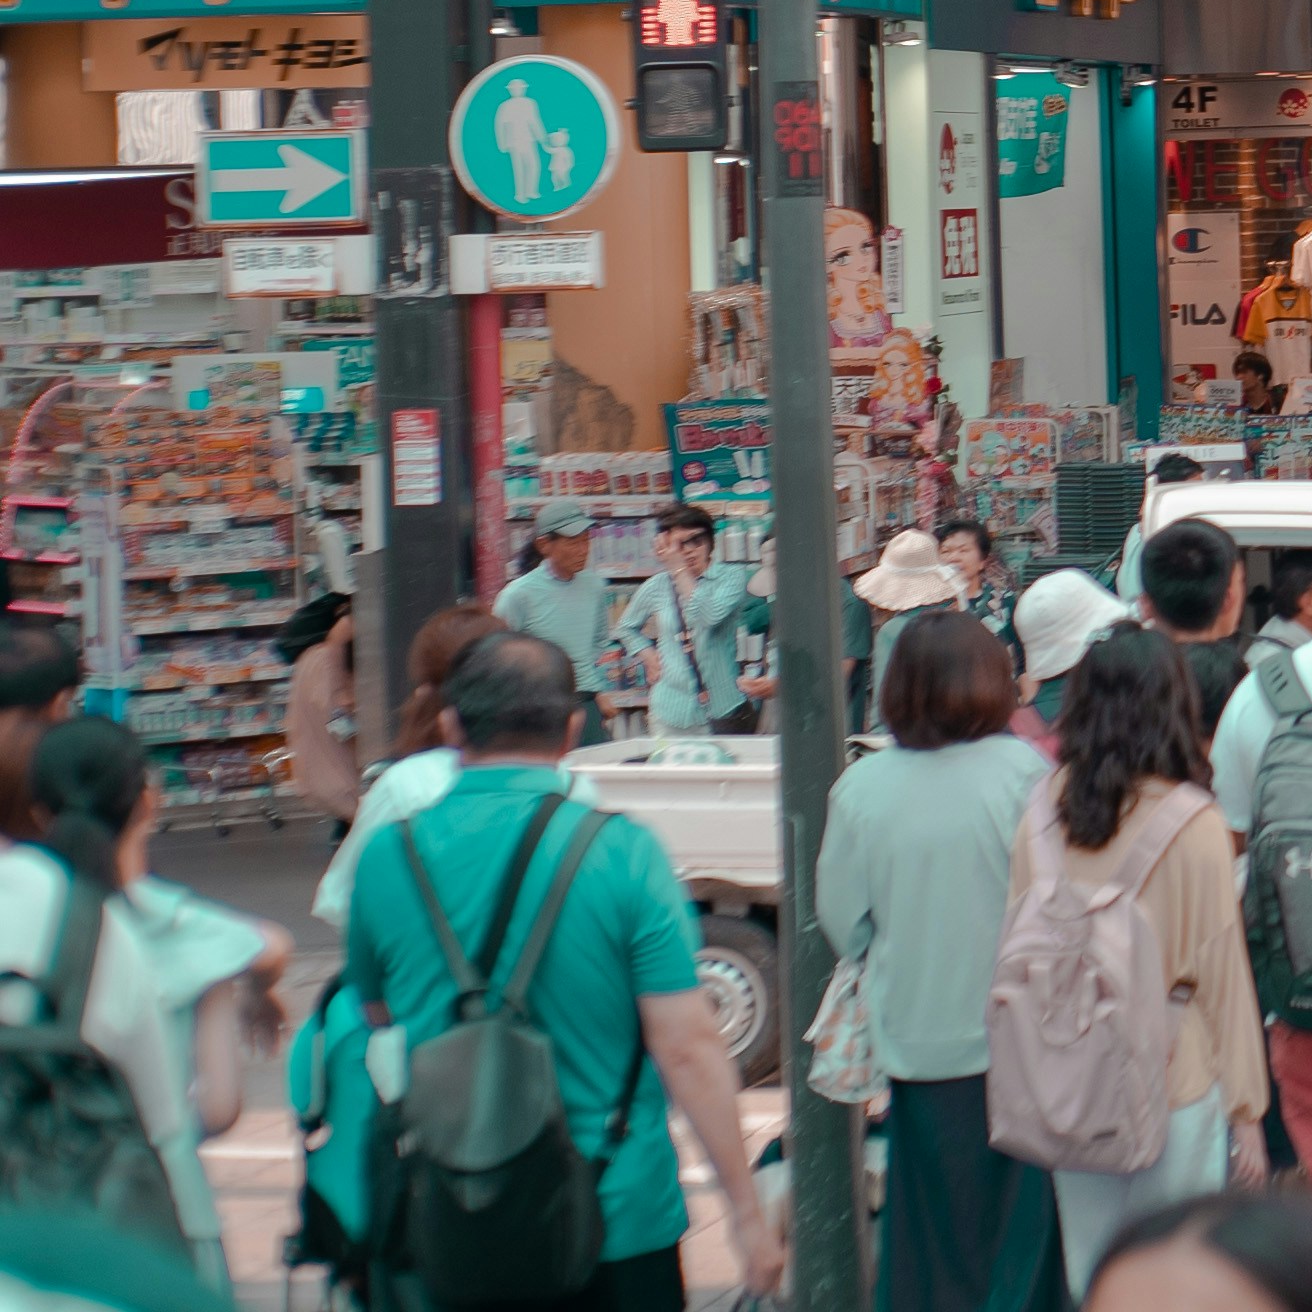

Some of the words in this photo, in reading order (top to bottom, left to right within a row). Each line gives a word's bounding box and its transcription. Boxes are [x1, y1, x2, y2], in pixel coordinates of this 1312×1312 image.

[1172, 86, 1219, 114] 4F
[1172, 117, 1221, 129] TOILET
[1169, 302, 1227, 327] FILA
